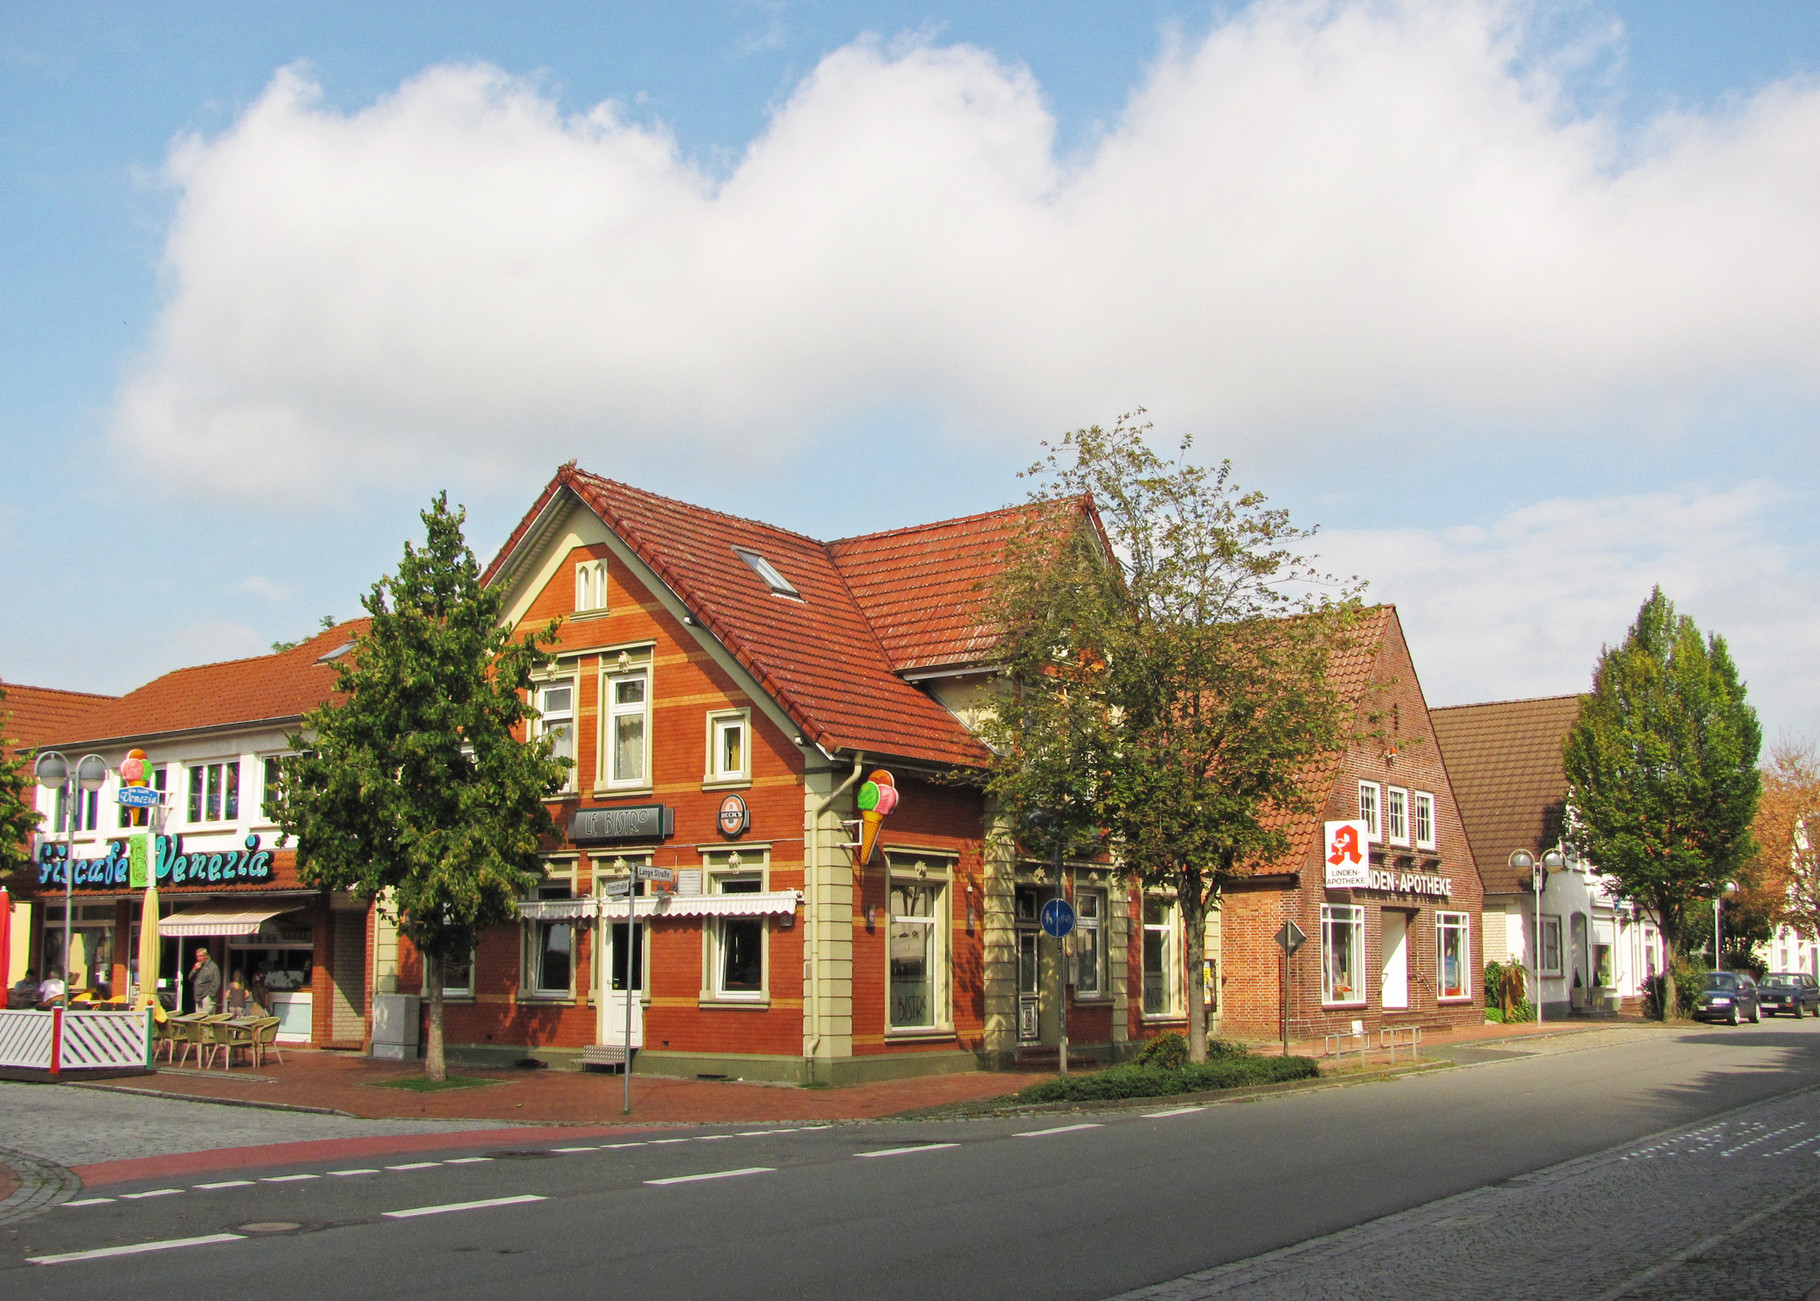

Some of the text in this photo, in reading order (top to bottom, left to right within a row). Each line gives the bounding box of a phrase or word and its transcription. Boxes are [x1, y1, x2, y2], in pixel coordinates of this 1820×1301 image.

[119, 791, 158, 804] Venezia
[585, 810, 649, 836] LE BISTRO
[155, 833, 270, 882] Venezia
[639, 867, 670, 879] Lange Straße
[1331, 869, 1361, 877] LINDEN-
[1326, 877, 1366, 885] APOTHEKE
[1619, 1120, 1820, 1160] BU
